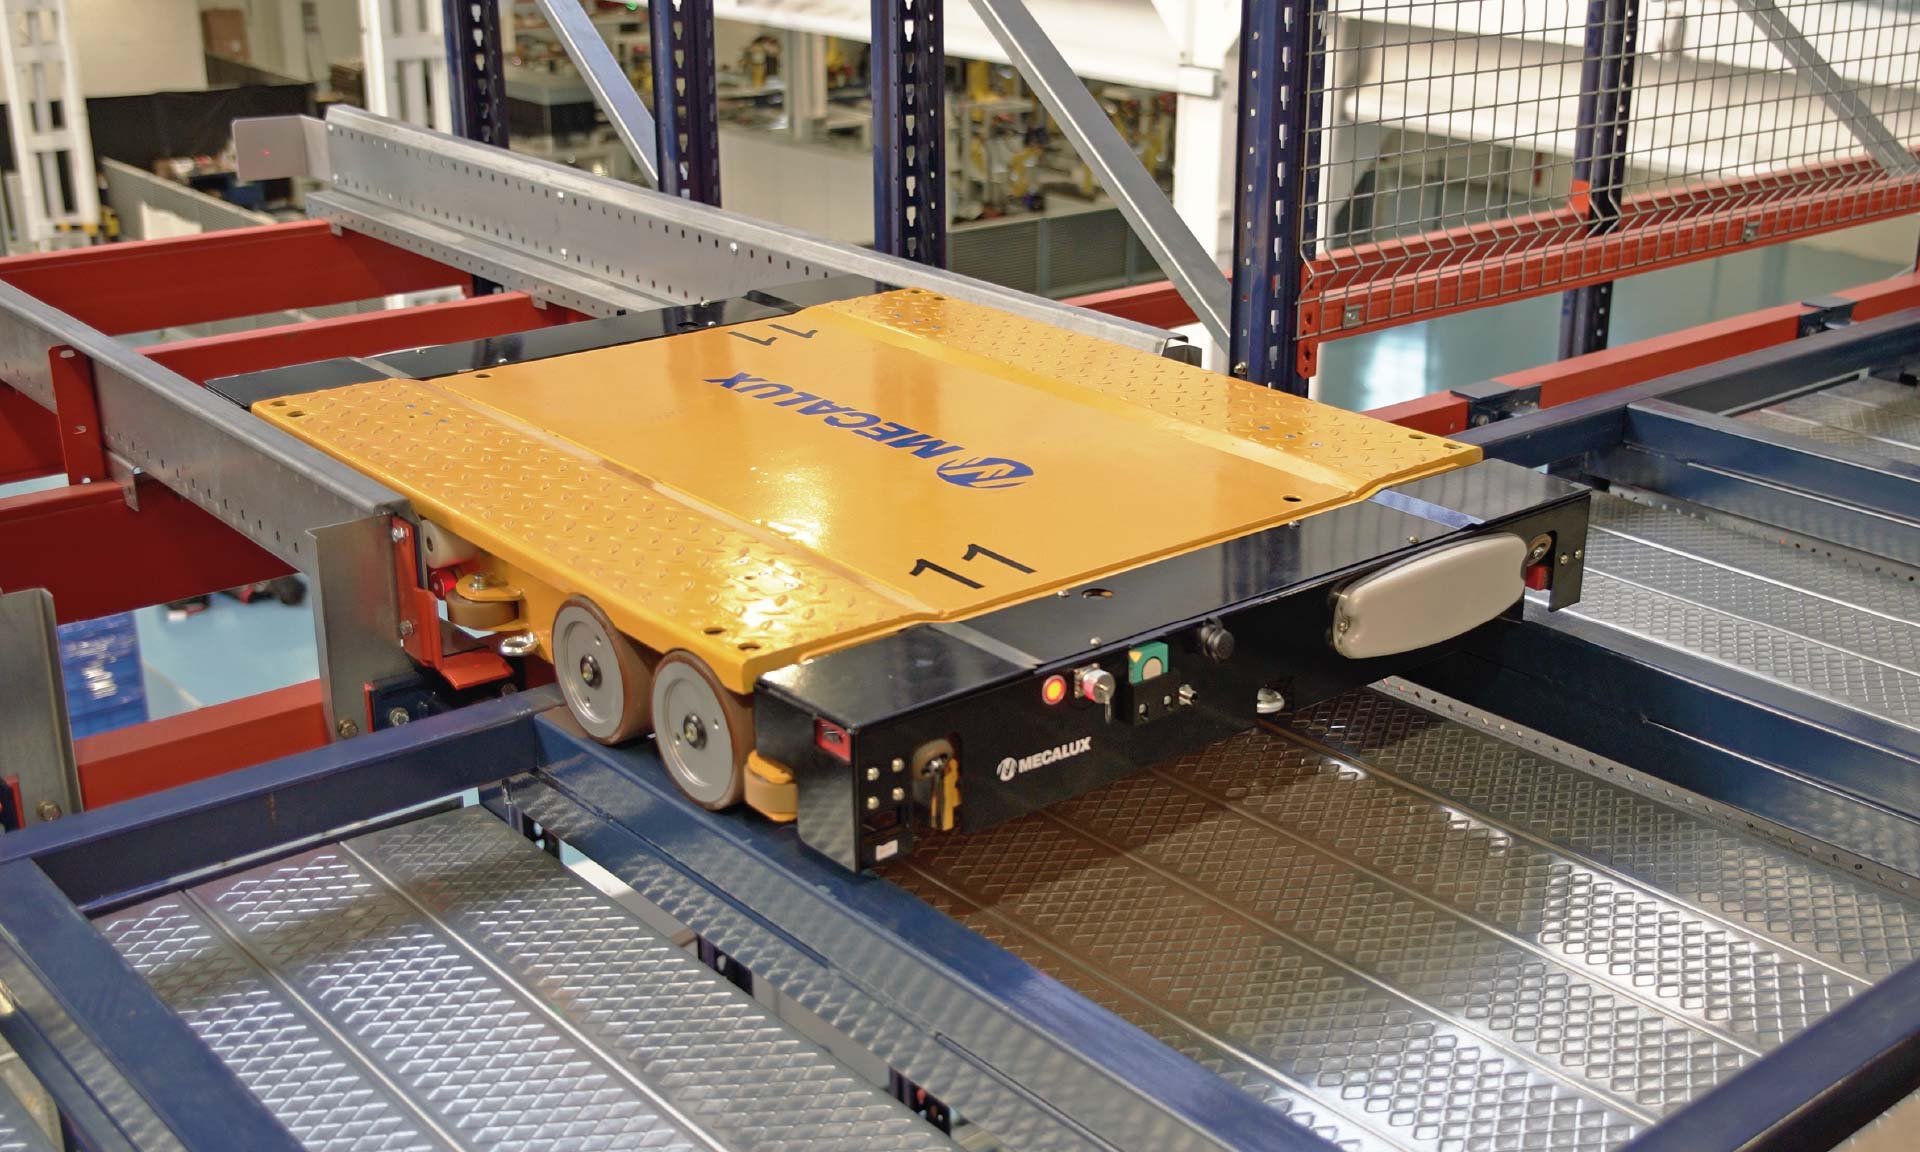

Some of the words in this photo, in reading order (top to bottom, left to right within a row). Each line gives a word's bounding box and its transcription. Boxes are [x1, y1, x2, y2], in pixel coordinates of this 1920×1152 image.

[728, 324, 818, 346] 11
[703, 372, 964, 459] MECALUX
[910, 544, 1037, 589] 11
[1018, 736, 1091, 774] MECALUX
